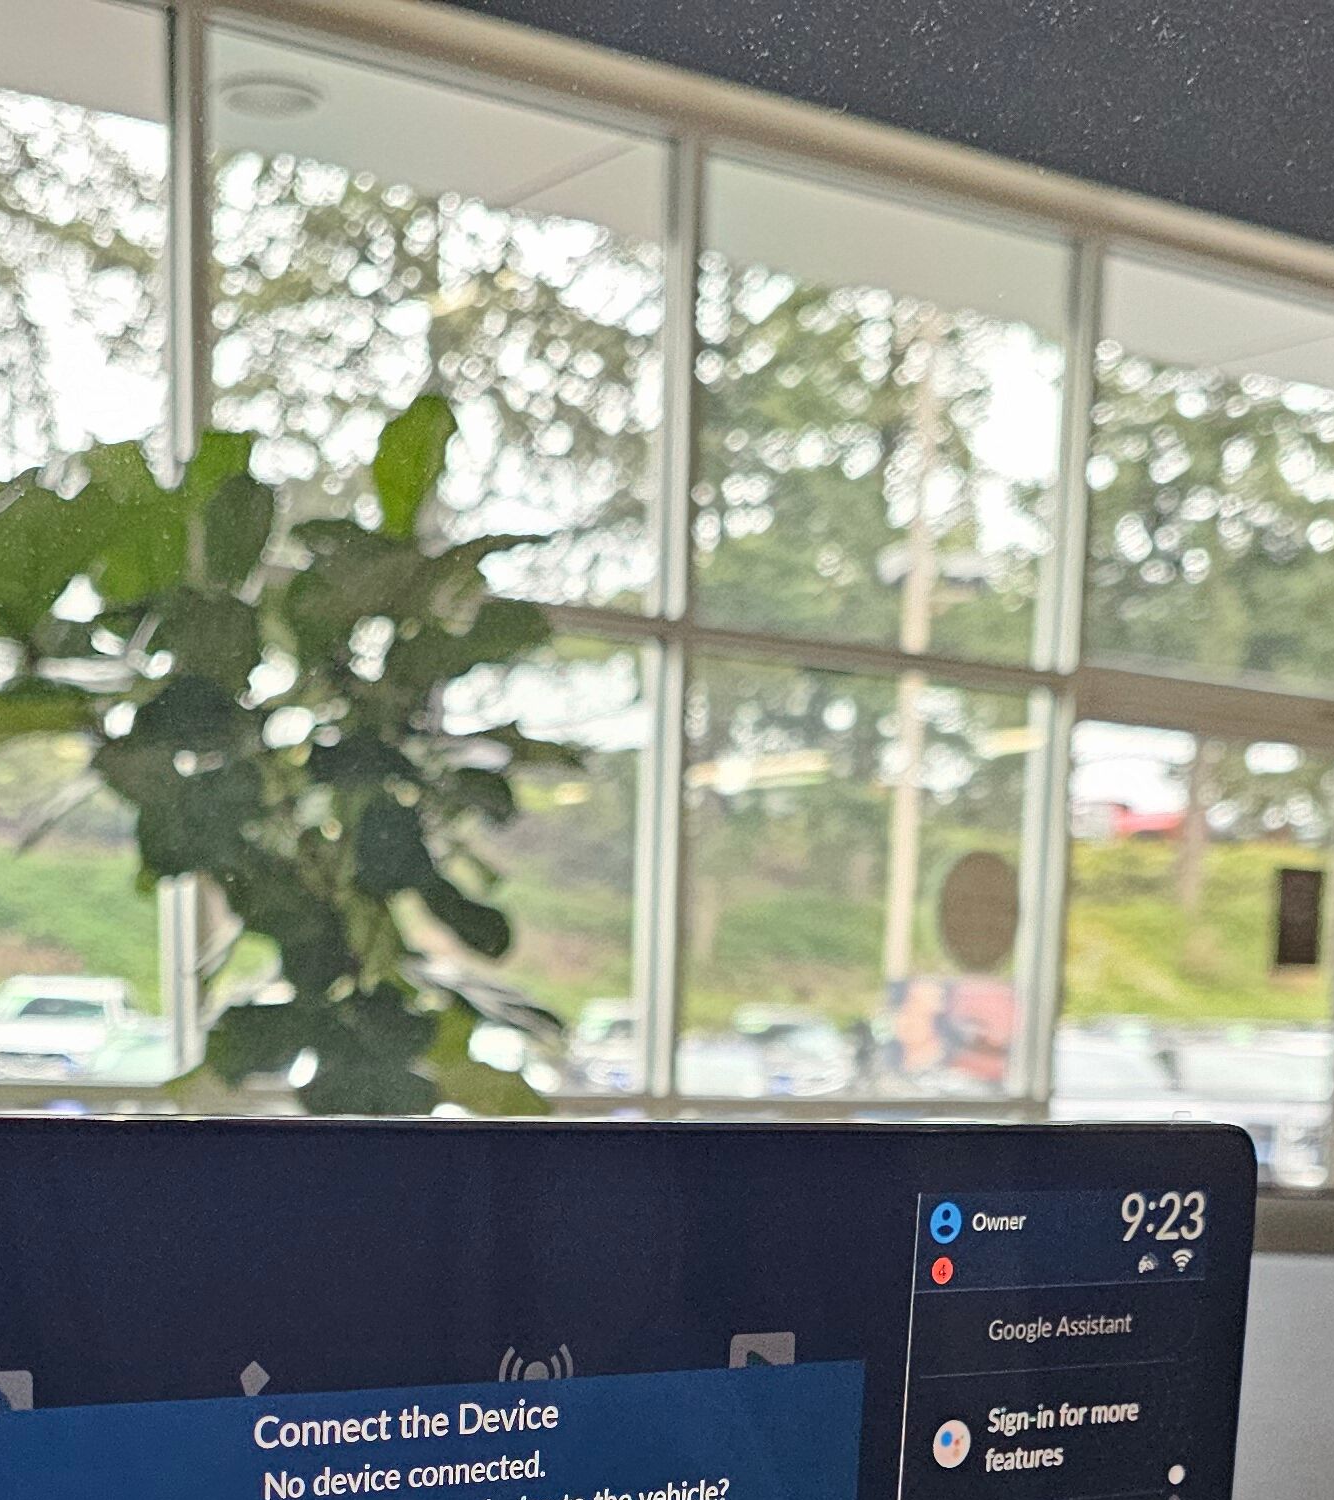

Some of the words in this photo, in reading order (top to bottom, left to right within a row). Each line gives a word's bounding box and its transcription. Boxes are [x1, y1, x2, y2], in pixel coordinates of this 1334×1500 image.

[972, 1212, 1026, 1233] Owner
[1121, 1190, 1207, 1243] 9:23
[988, 1317, 1053, 1344] Google
[1056, 1313, 1132, 1339] Assistant
[254, 1411, 392, 1449] Connect
[399, 1406, 449, 1440] the
[458, 1398, 560, 1437] Device
[987, 1405, 1054, 1438] Sign-in
[1059, 1403, 1089, 1428] for
[1092, 1401, 1139, 1423] more
[264, 1471, 305, 1500] No
[313, 1463, 400, 1496] device
[408, 1451, 547, 1488] connected.
[985, 1447, 1064, 1473] features
